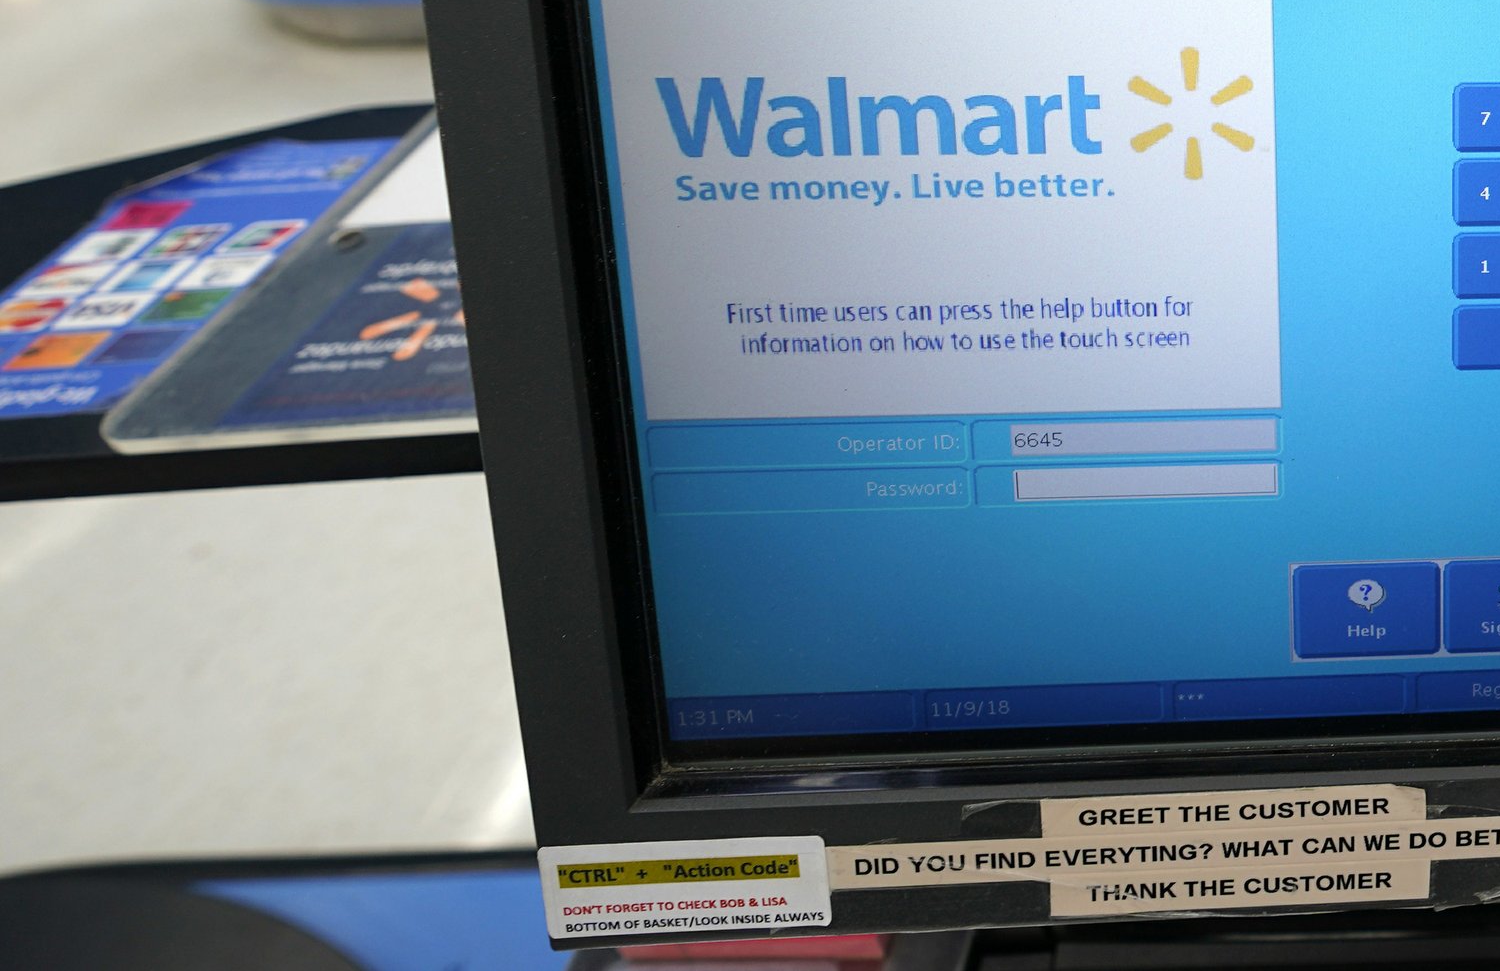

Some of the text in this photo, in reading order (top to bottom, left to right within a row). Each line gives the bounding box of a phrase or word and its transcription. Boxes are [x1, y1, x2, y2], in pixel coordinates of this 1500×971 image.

[653, 73, 1104, 160] Walmart
[1480, 111, 1491, 126] 7
[675, 171, 1115, 207] Save money. Live better.
[1480, 186, 1490, 200] 4
[1480, 259, 1490, 274] 1
[726, 295, 1193, 326] First time users can press the help button for
[741, 328, 1190, 355] information on how to use the touch screen
[835, 434, 960, 455] Operator ID:
[1014, 431, 1063, 448] 6645
[866, 479, 963, 497] Password:
[1347, 624, 1386, 640] Help
[676, 708, 754, 729] 1:31 PM
[931, 699, 1010, 718] 11/9/18
[1078, 797, 1390, 827] GREET THE CUSTOMER
[854, 857, 900, 876] DID
[908, 854, 965, 873] YOU
[975, 851, 1036, 870] FIND
[1045, 843, 1214, 868] EVERYTING?
[1221, 839, 1294, 859] WHAT
[1301, 835, 1355, 855] CAN
[1363, 833, 1401, 852] WE
[1409, 831, 1447, 850] DO
[558, 859, 798, 885] "CTRL" + "Action Code"
[1087, 872, 1392, 902] THANK THE CUSTOMER
[605, 902, 654, 914] FORGET
[656, 901, 675, 911] TO
[677, 899, 717, 911] CHECK
[719, 898, 746, 909] BOB
[748, 897, 759, 907] &
[761, 896, 788, 907] LISA
[565, 911, 825, 933] BOTTOM OF BASKET/LOOK INSIDE ALWAYS
